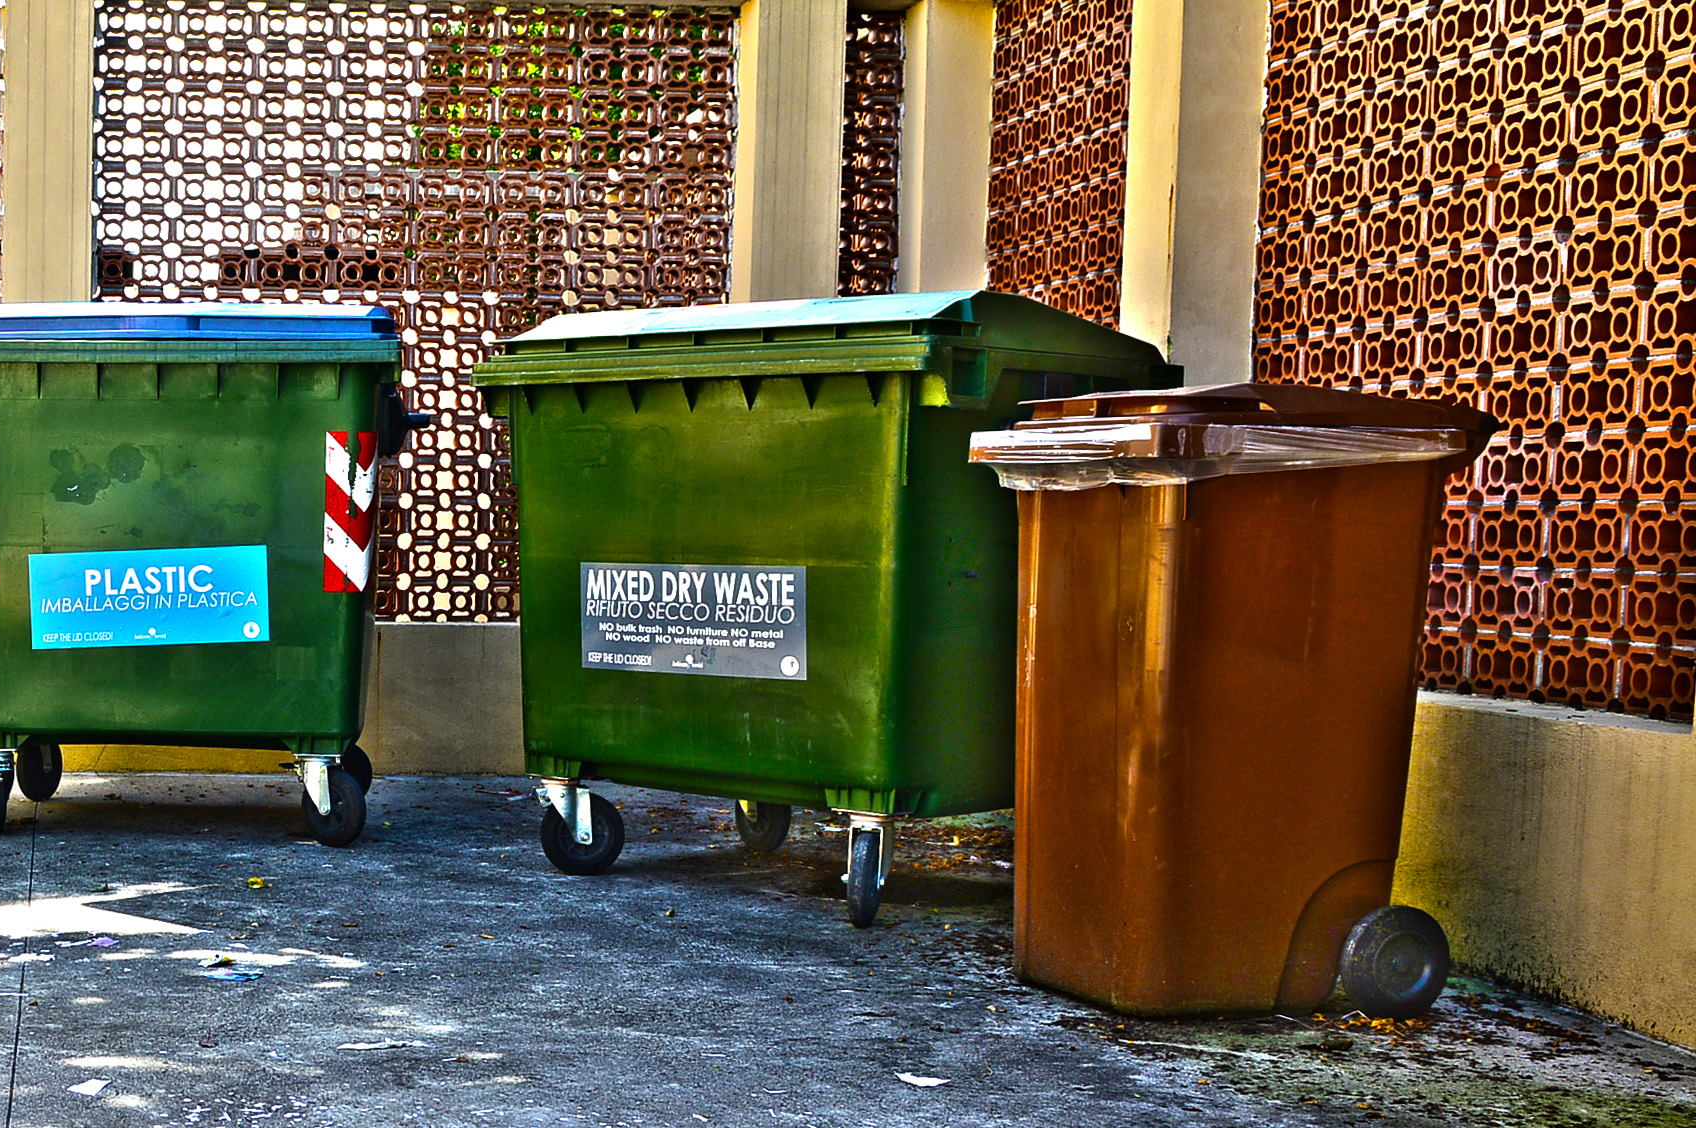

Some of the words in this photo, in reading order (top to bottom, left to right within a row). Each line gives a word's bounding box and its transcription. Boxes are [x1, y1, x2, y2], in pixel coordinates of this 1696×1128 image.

[84, 564, 214, 596] PLASTIC
[586, 569, 655, 602] MIXED
[661, 570, 707, 604] DRY
[713, 572, 795, 606] WASTE
[40, 595, 150, 614] IMBALLAGGI
[154, 593, 171, 609] IN
[177, 591, 258, 609] PLASTICA
[586, 600, 643, 619] RIFIUTO
[647, 602, 710, 621] SECCO
[715, 604, 796, 625] RESIDUO
[42, 633, 58, 643] KEEP
[59, 632, 71, 642] THE
[72, 632, 83, 642] LID
[84, 631, 114, 642] CLOSED!
[599, 622, 614, 632] NO
[616, 622, 637, 633] bulk
[638, 623, 663, 634] trash
[667, 625, 684, 635] NO
[686, 626, 729, 638] furniture
[730, 628, 749, 638] NO
[750, 629, 784, 639] metal
[605, 632, 621, 641] NO
[622, 633, 650, 643] wood
[655, 635, 672, 644] NO
[673, 636, 704, 646] waste
[705, 637, 730, 647] from
[732, 638, 747, 648] off
[748, 638, 776, 649] Base
[588, 652, 602, 662] KEEP
[602, 652, 614, 664] THE
